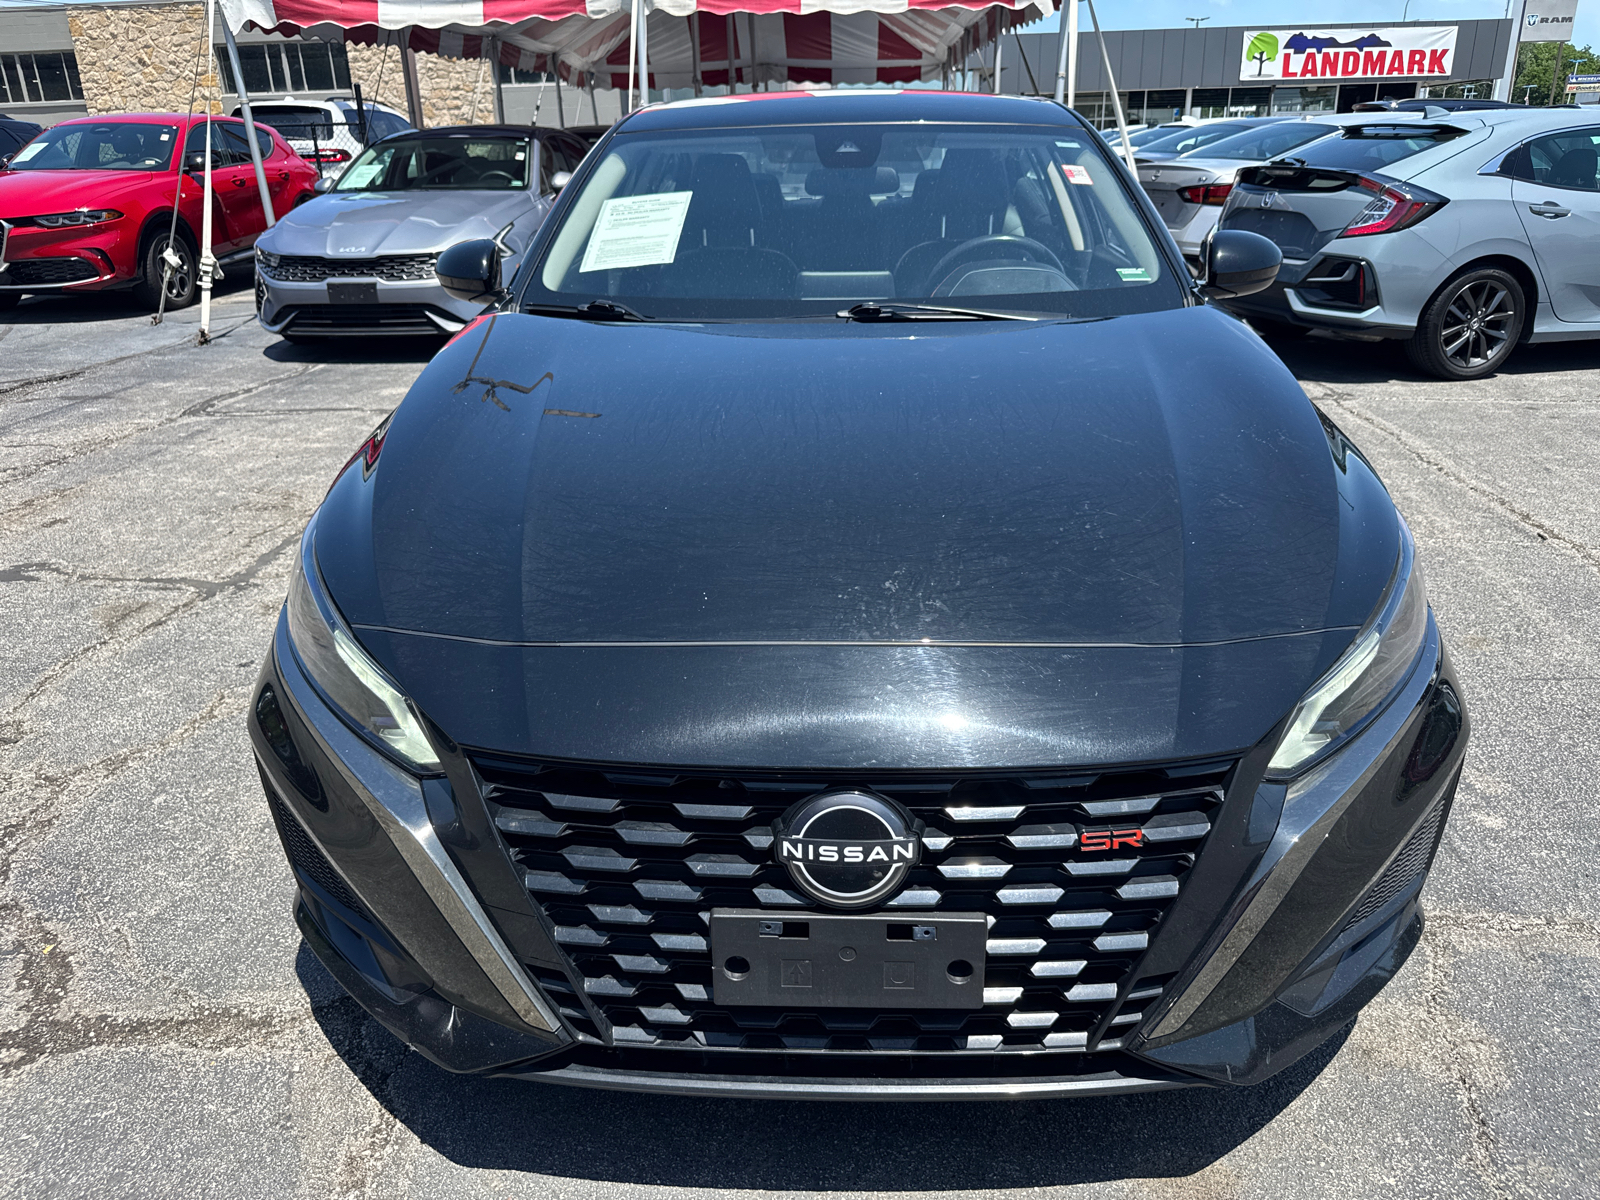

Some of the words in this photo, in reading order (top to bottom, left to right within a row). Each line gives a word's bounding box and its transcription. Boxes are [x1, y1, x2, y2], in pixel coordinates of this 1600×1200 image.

[1282, 49, 1450, 78] LANDMARK
[1081, 829, 1143, 851] SR
[783, 841, 913, 862] NISSAN
